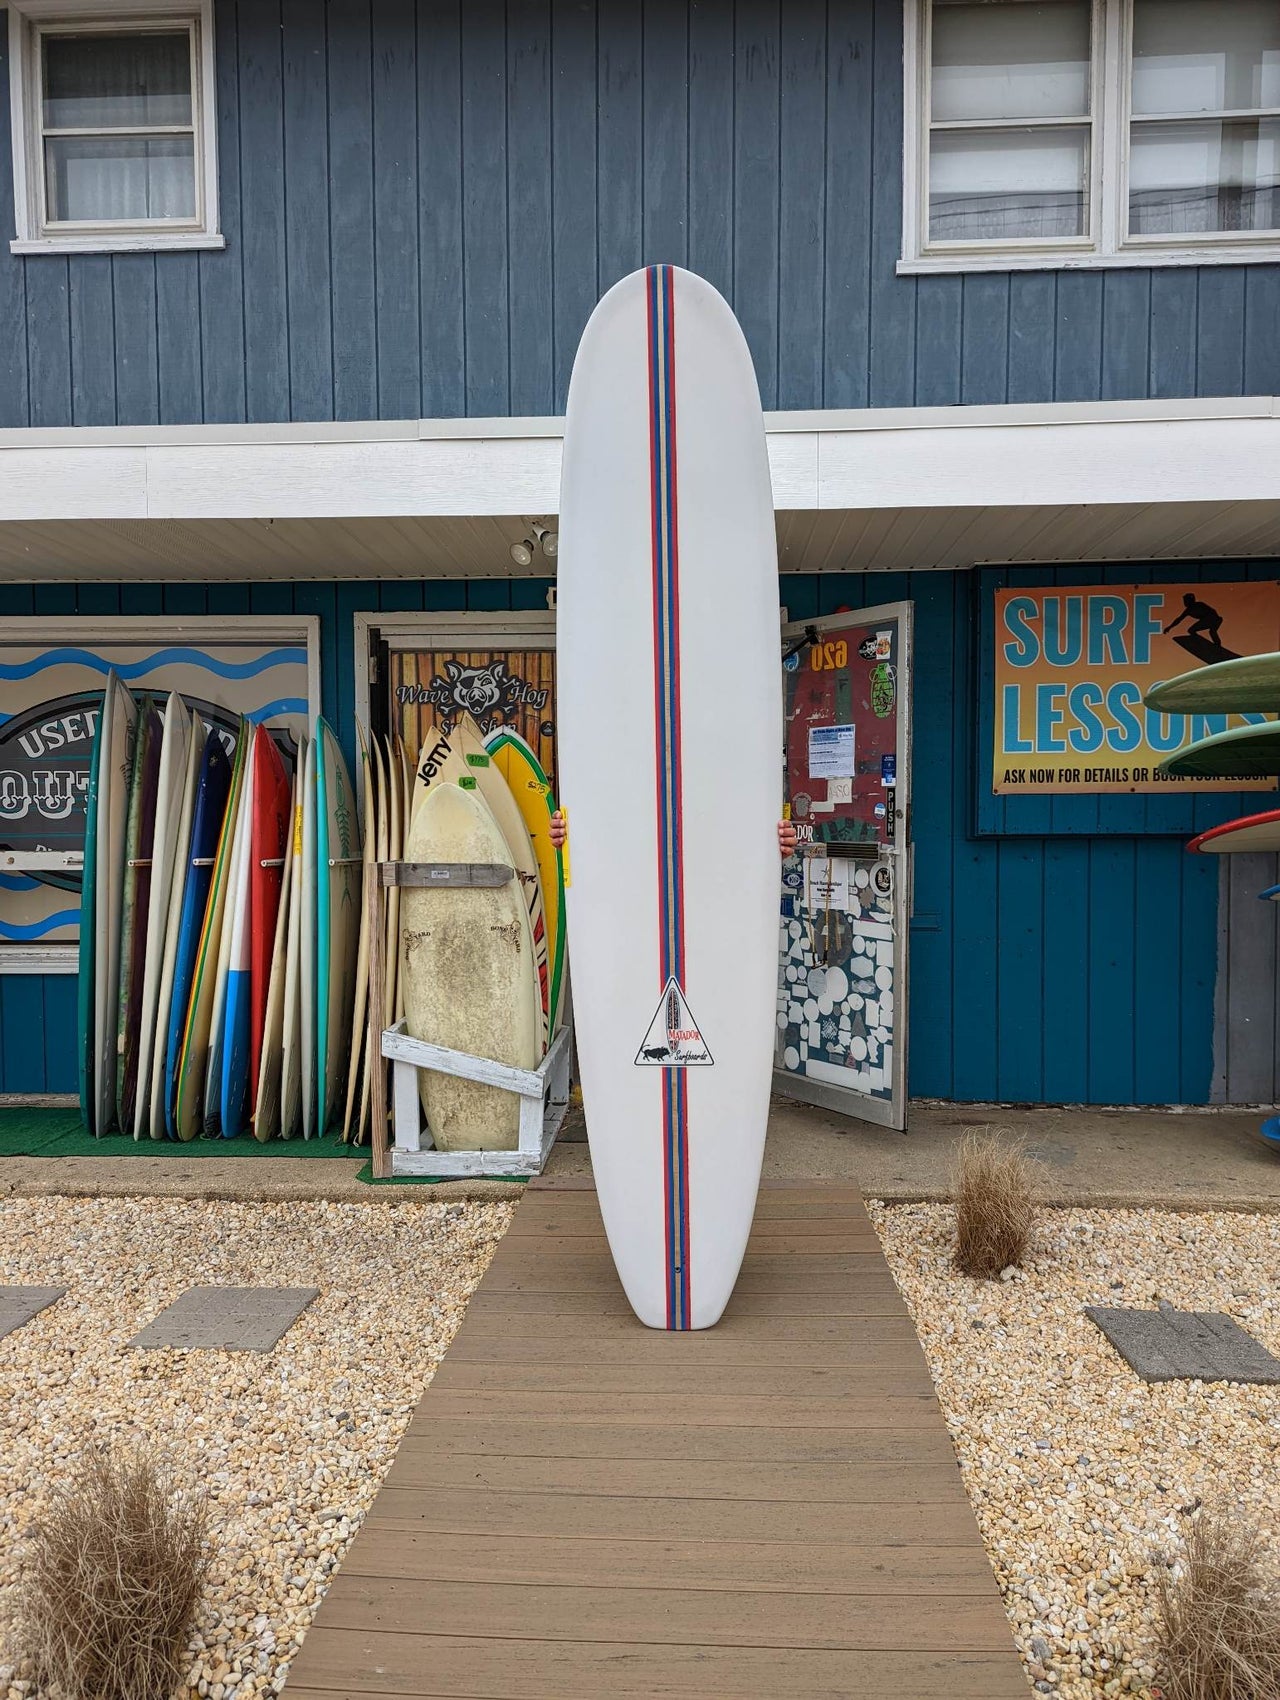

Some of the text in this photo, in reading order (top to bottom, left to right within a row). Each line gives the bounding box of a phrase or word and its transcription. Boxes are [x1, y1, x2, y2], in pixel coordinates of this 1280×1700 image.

[1003, 593, 1165, 668] SURF
[396, 683, 548, 709] Wave Hog
[1002, 680, 1269, 754] LESSO
[1003, 769, 1026, 784] ASK
[1029, 769, 1055, 783] NOW
[1058, 768, 1081, 782] FOR
[1084, 767, 1129, 783] DETAILS
[1132, 767, 1149, 782] OR
[887, 791, 895, 833] PUSH
[668, 1029, 700, 1041] MATADOR
[674, 1049, 707, 1064] Surfboards
